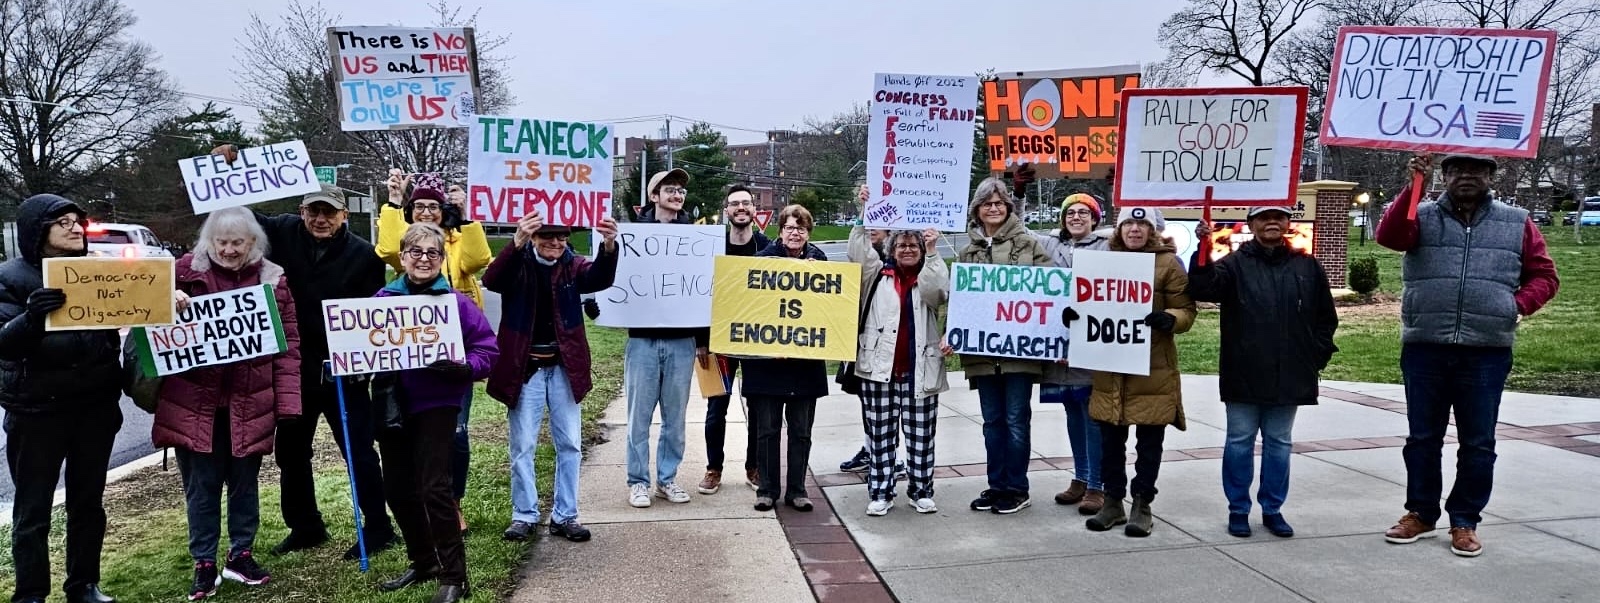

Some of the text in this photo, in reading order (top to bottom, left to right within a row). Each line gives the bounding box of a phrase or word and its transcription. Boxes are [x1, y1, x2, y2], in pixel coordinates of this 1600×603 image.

[334, 31, 466, 50] There is NO
[343, 54, 470, 75] US and THEM
[342, 76, 456, 104] There is
[884, 75, 911, 86] Hands
[936, 78, 966, 88] 2025
[1338, 67, 1520, 104] NOT IN THE
[350, 101, 400, 124] only
[408, 95, 447, 120] US
[875, 90, 948, 107] CONGRESS
[885, 116, 939, 132] Fearful
[929, 107, 975, 122] FRAUD
[1144, 98, 1269, 126] RALLY FOR
[1378, 102, 1471, 139] USA
[478, 117, 608, 159] TEANECK
[990, 144, 1004, 161] IF
[1009, 135, 1056, 155] EGGS
[1060, 146, 1071, 162] R
[1077, 146, 1087, 162] 2
[1178, 123, 1249, 150] GOOD
[261, 145, 298, 165] the
[884, 148, 911, 165] Are
[190, 161, 310, 202] URGENCY
[504, 160, 592, 184] IS FOR
[470, 185, 611, 228] EVERYONE
[866, 202, 893, 223] HANDS
[882, 206, 899, 223] OFF
[906, 200, 930, 209] Social
[620, 231, 725, 257] ROTECT
[64, 266, 156, 286] Democracy
[747, 269, 842, 294] ENOUGH
[956, 265, 1072, 297] DEMOCRACY
[97, 288, 124, 300] Not
[1076, 277, 1152, 304] DEFUND
[68, 305, 152, 323] Oligarchy
[177, 292, 257, 324] UMP IS
[327, 304, 449, 332] EDUCATION
[995, 300, 1054, 325] NOT
[151, 311, 271, 352] NOT ABOVE
[368, 326, 440, 347] CUTS
[730, 322, 827, 348] ENOUGH
[1087, 314, 1146, 345] DOGE
[158, 333, 262, 371] THE LAW
[948, 328, 1070, 360] OLIGARCHY
[332, 341, 465, 375] NEVER HEAL
